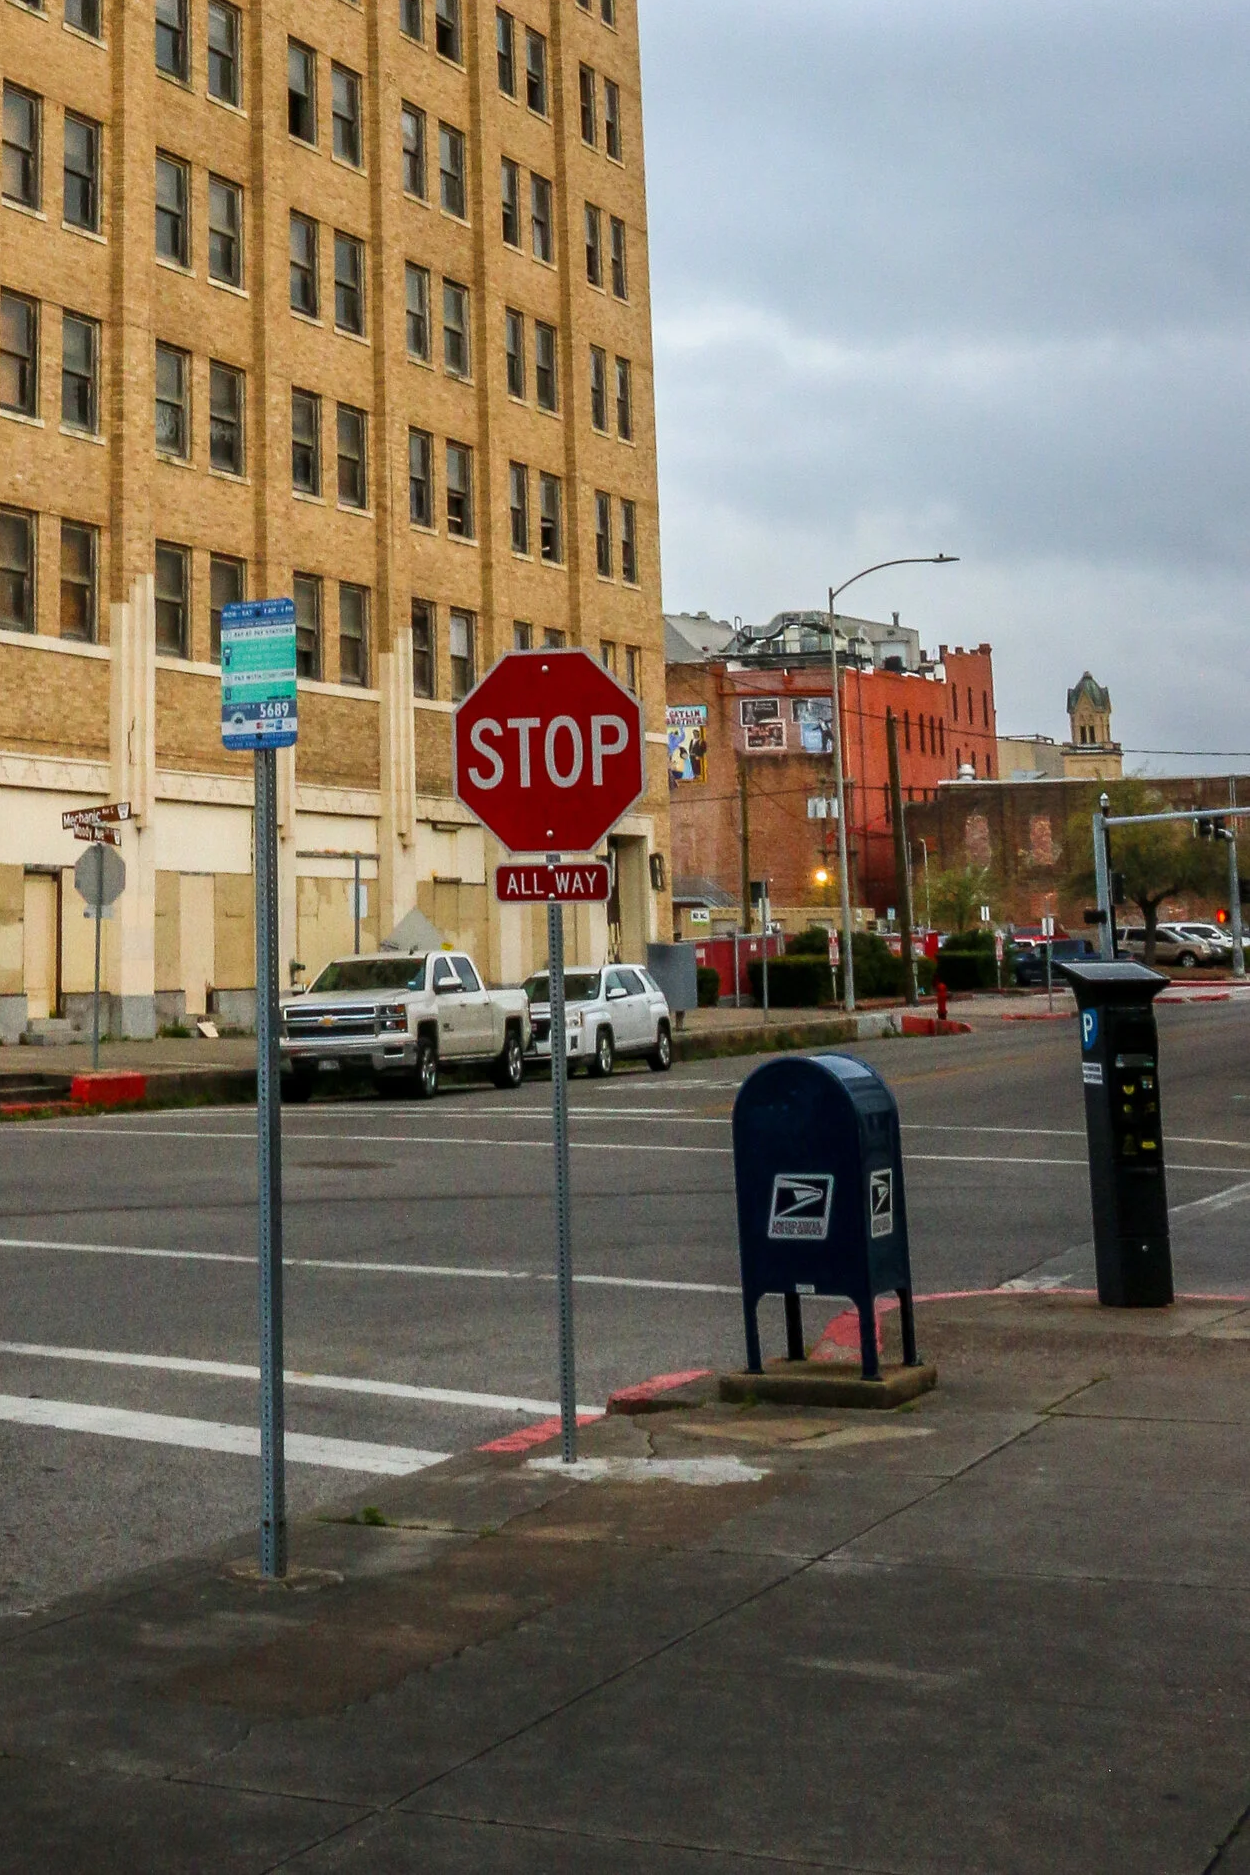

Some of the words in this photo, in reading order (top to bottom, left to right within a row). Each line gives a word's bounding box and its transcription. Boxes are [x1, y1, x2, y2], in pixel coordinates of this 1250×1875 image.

[259, 702, 289, 718] 5689
[468, 715, 629, 790] STOP
[63, 809, 101, 827] Mechanic
[506, 873, 544, 895] ALL
[555, 871, 597, 893] WAY
[1082, 1013, 1093, 1042] P
